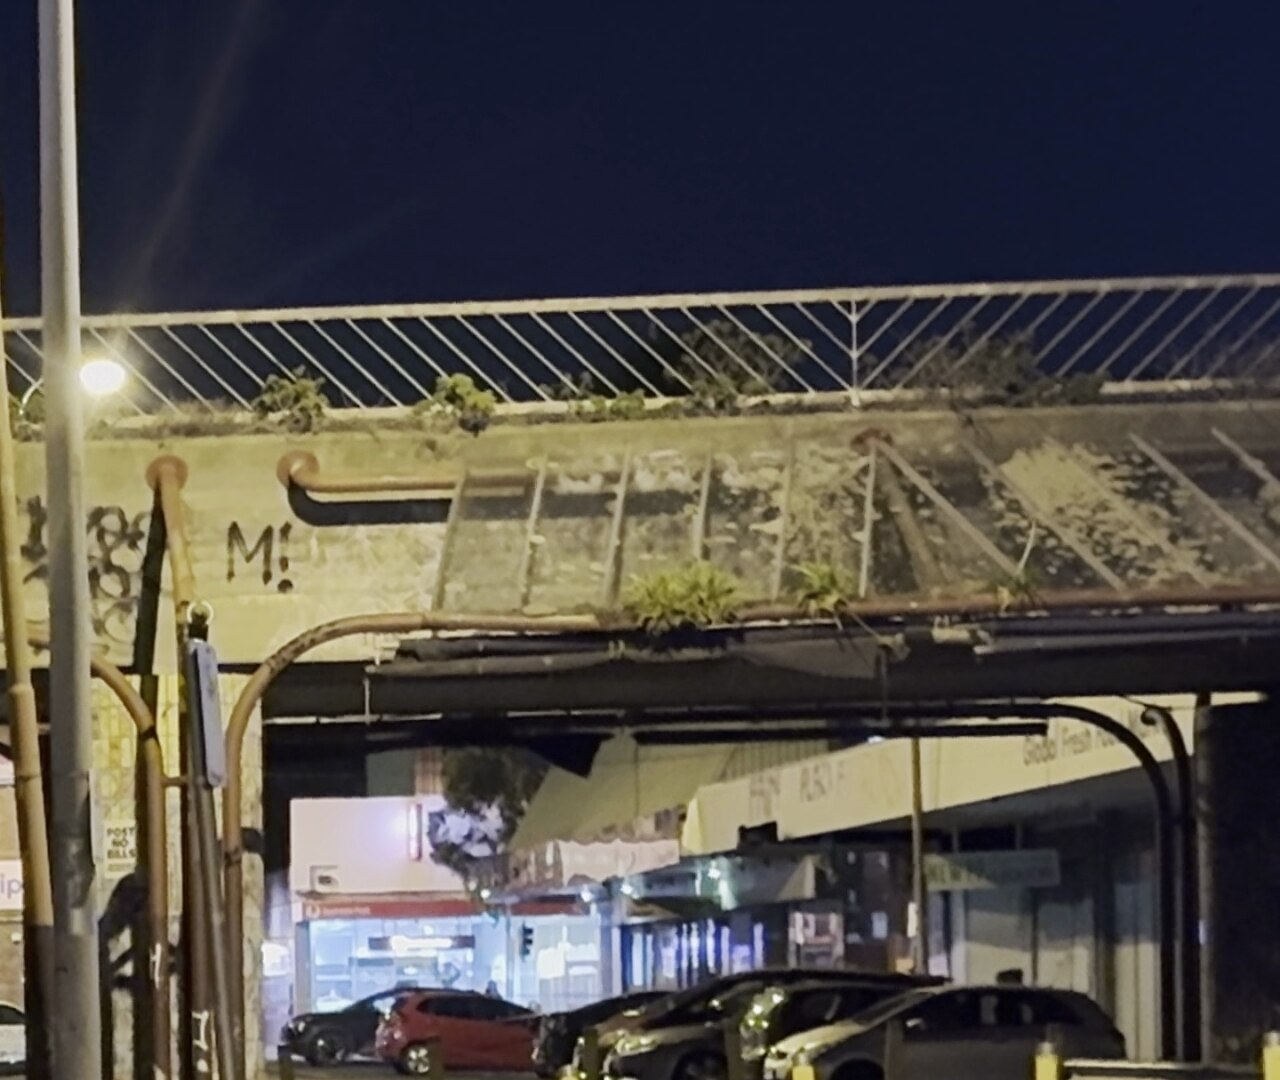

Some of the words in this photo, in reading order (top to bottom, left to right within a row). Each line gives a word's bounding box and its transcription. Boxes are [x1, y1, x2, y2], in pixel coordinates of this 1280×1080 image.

[106, 827, 136, 837] POST
[112, 838, 129, 848] NO
[106, 849, 137, 859] BILLS
